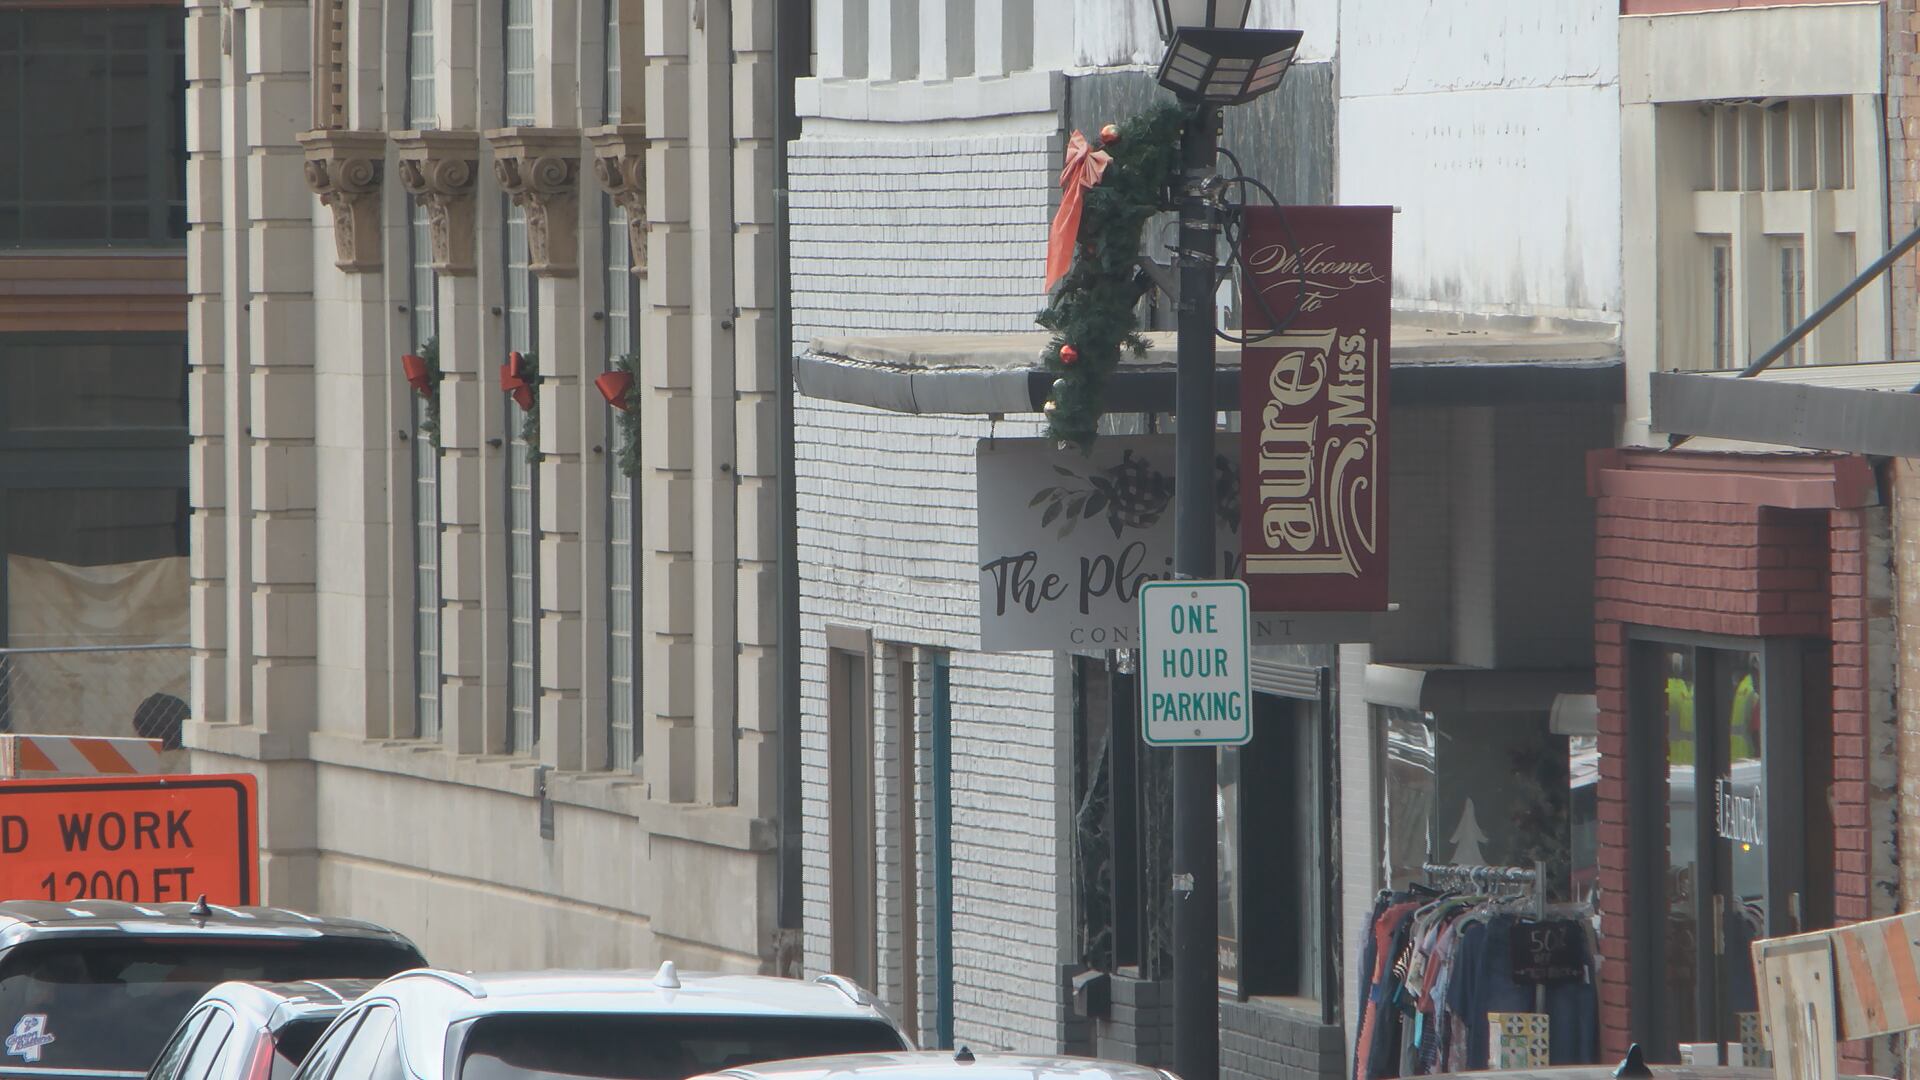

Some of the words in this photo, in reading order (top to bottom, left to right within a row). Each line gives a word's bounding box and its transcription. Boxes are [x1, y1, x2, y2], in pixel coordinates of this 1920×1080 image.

[1249, 243, 1384, 283] Welcome
[1297, 293, 1338, 312] to
[1246, 327, 1367, 578] Laurel
[981, 551, 1068, 616] The
[1171, 604, 1218, 634] ONE
[1163, 648, 1228, 679] HOUR
[1152, 692, 1241, 723] PARKING
[58, 810, 194, 852] WORK
[41, 869, 138, 901] 1200
[154, 867, 195, 902] FT
